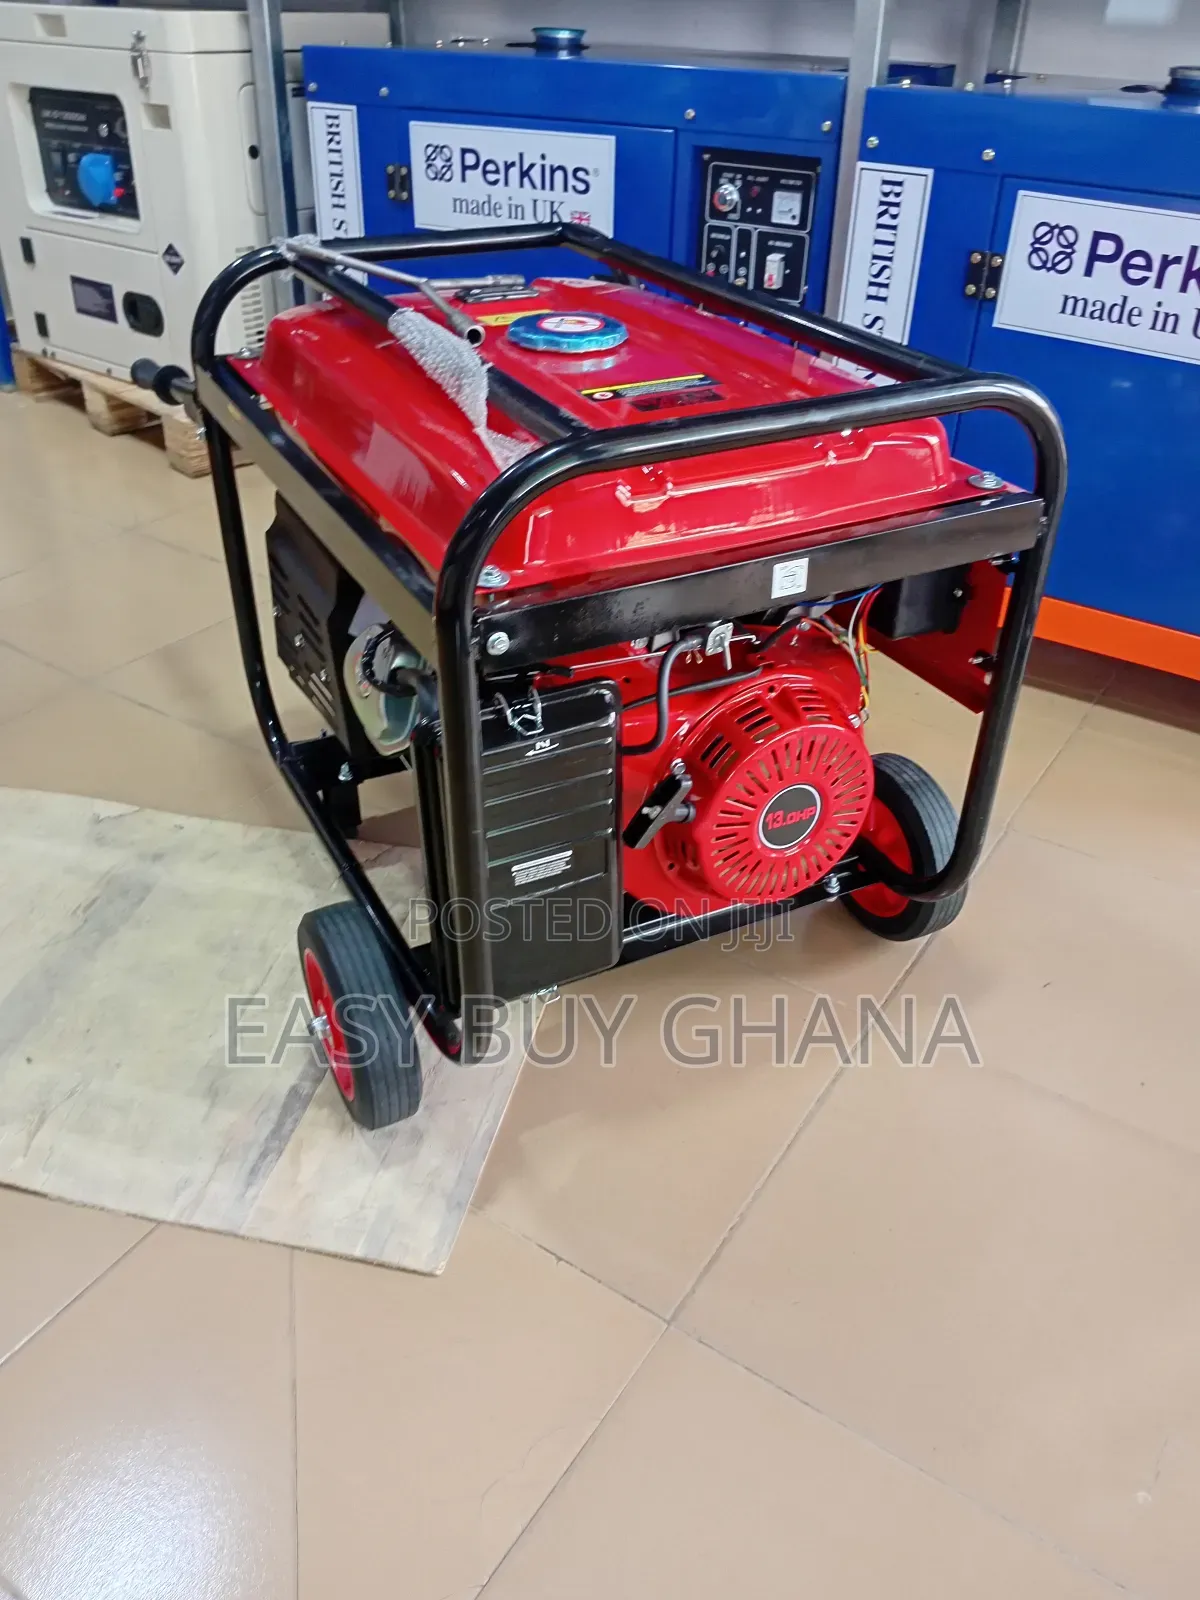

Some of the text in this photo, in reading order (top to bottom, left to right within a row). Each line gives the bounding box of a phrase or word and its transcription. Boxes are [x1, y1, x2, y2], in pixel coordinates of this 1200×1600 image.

[325, 114, 346, 210] BRITISH
[459, 147, 591, 195] Perkins
[452, 194, 565, 224] made in UK
[866, 176, 904, 304] BRITISH
[1059, 295, 1143, 328] made
[1149, 301, 1180, 335] in
[766, 805, 817, 831] 13.0HP
